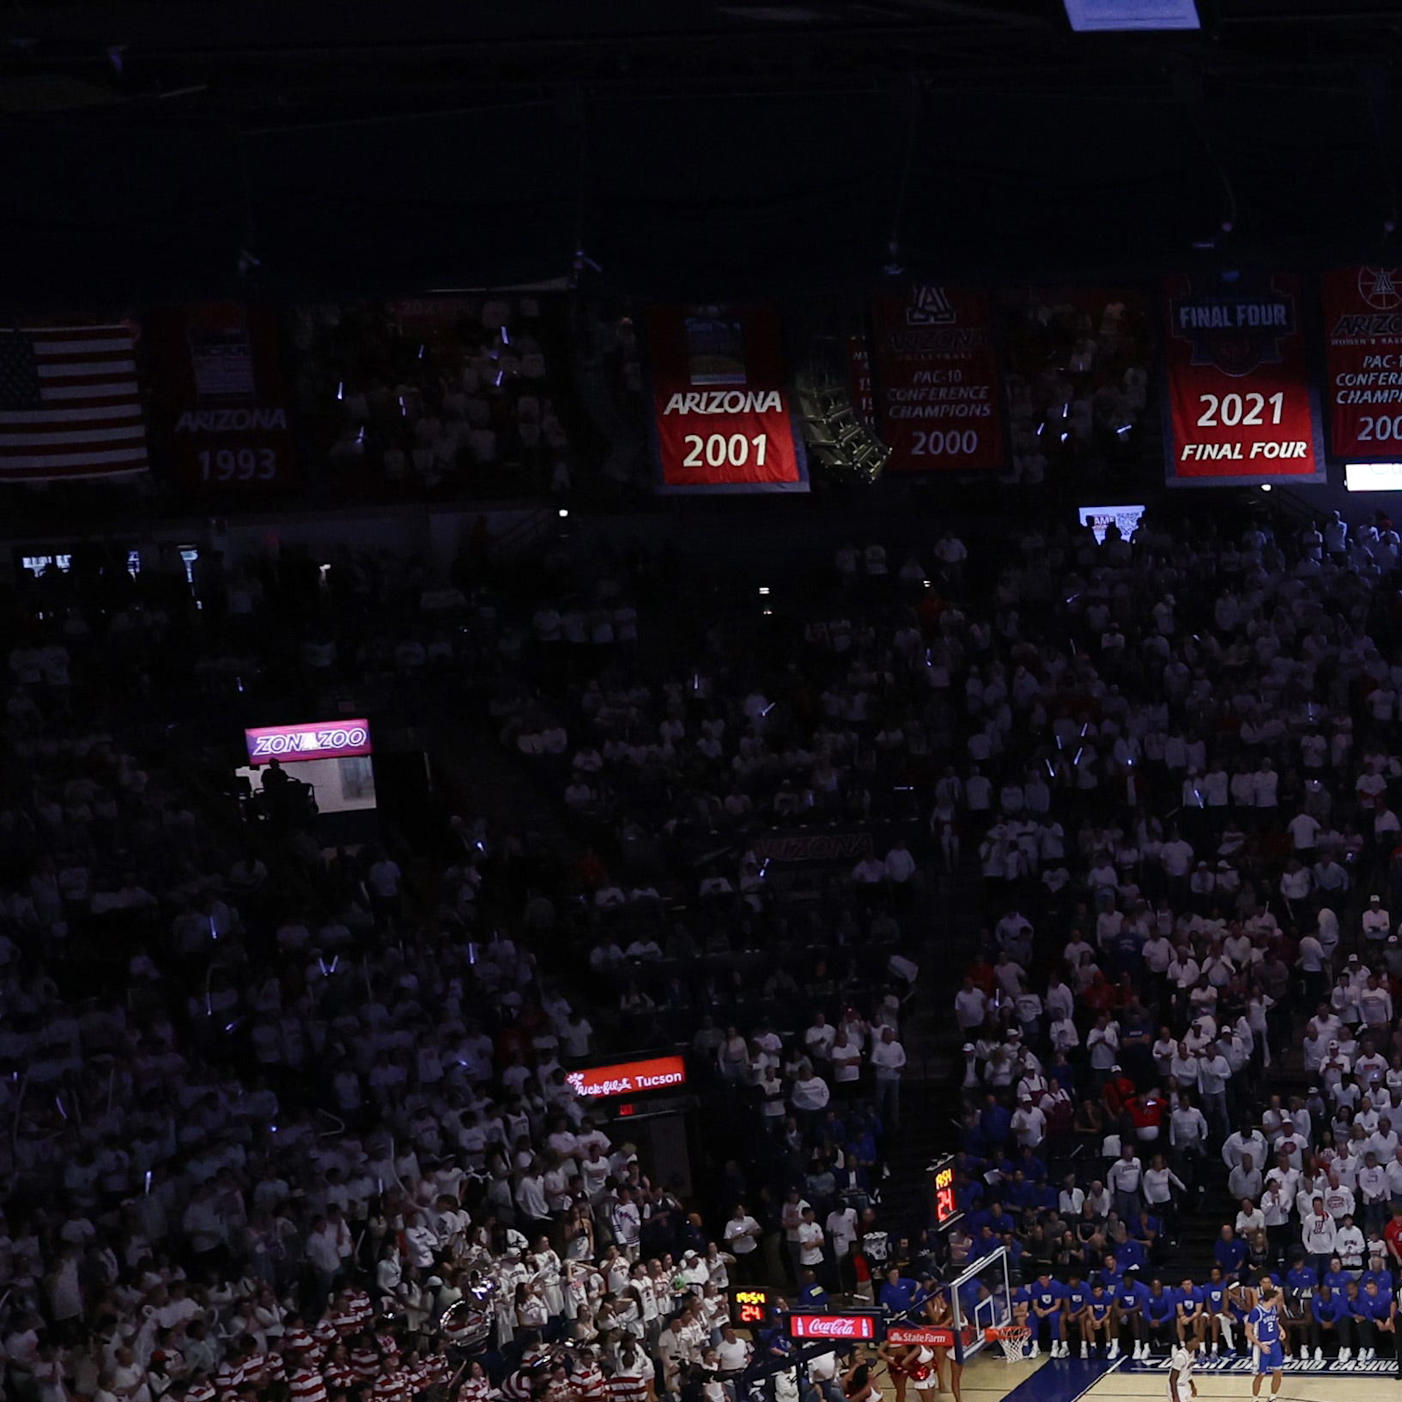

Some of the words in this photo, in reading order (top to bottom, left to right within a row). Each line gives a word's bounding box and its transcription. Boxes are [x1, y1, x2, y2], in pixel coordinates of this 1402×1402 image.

[1180, 304, 1233, 328] FINAL
[1236, 304, 1288, 327] FOUR
[912, 369, 963, 384] PAC-10
[663, 390, 783, 416] ARIZONA
[888, 385, 990, 401] CONFERENCE
[889, 403, 992, 419] CHAMPIONS
[1197, 391, 1285, 427] 2021
[174, 408, 288, 433] ARIZONA
[683, 433, 768, 467] 2001
[911, 430, 979, 456] 2000
[1181, 442, 1245, 461] FINAL
[1250, 441, 1308, 460] FOUR
[199, 448, 278, 481] 1993
[635, 1072, 682, 1088] Tucson
[741, 1305, 761, 1321] 24
[1267, 1322, 1274, 1332] 2
